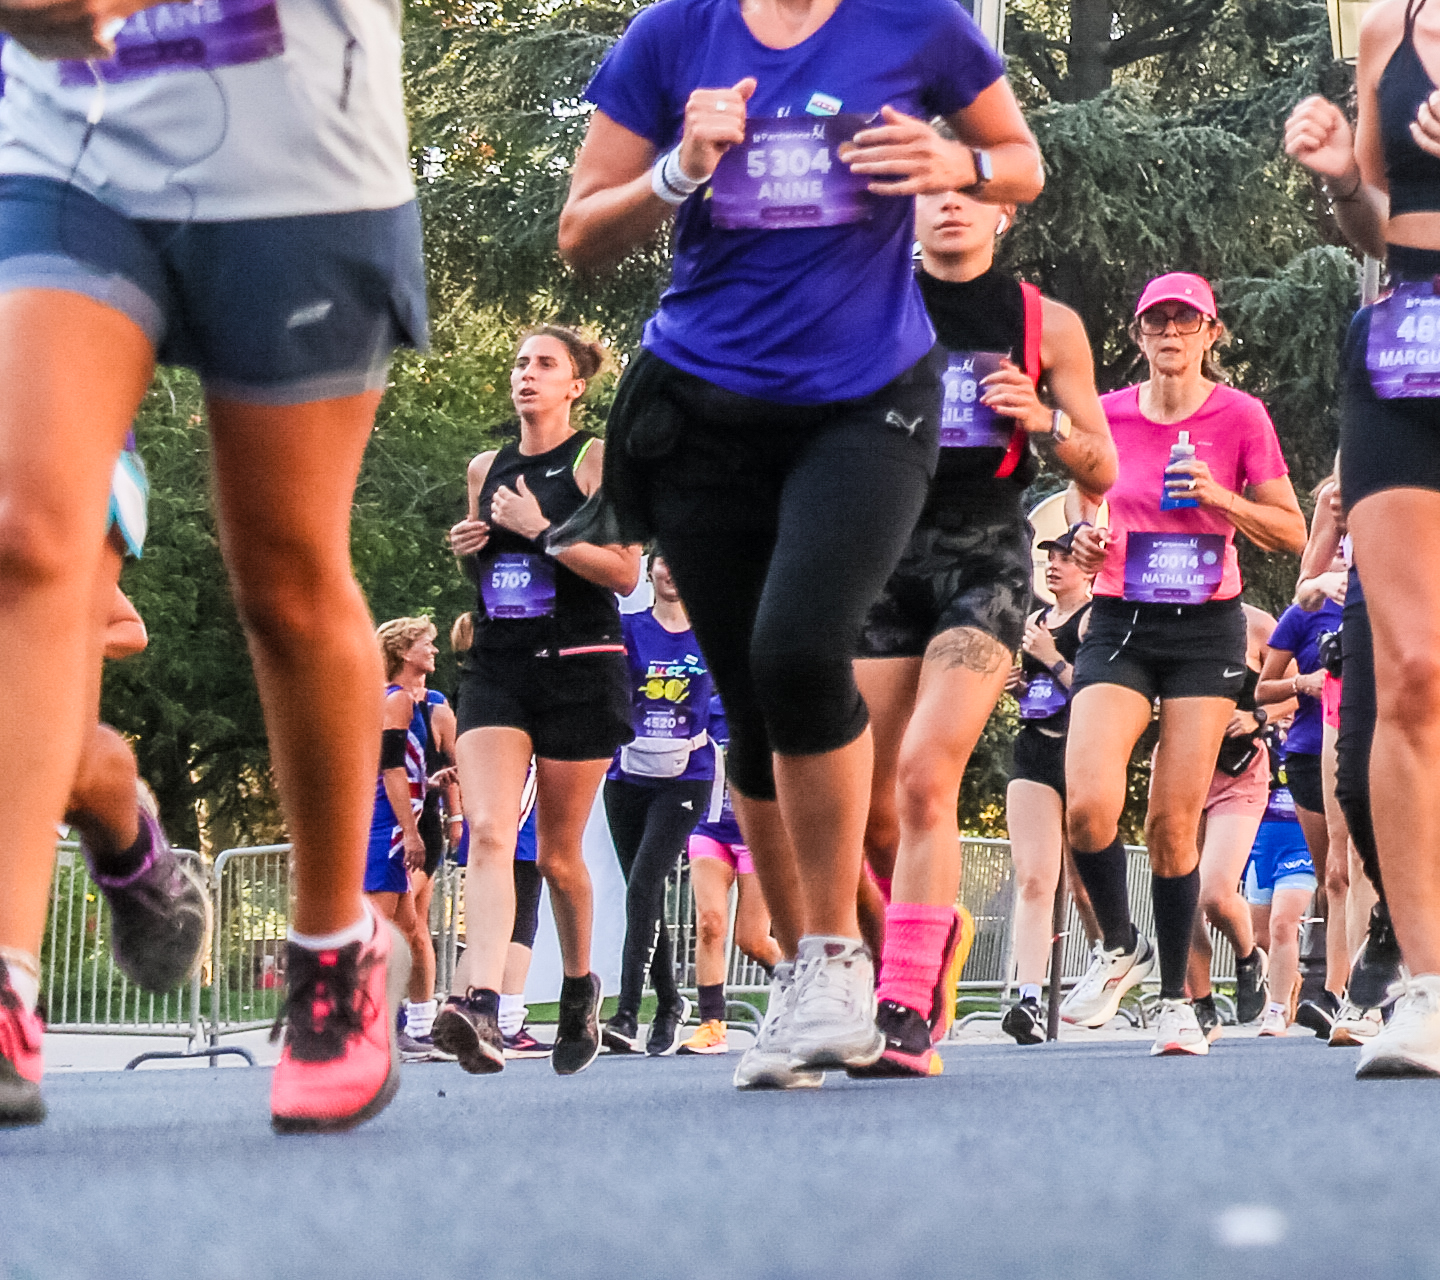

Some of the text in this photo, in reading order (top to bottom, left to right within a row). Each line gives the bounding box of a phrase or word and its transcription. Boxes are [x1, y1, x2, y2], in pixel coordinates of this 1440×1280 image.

[747, 147, 832, 178] 5304
[757, 180, 824, 200] ANNE
[1148, 553, 1199, 569] 20014
[492, 571, 531, 588] 5709
